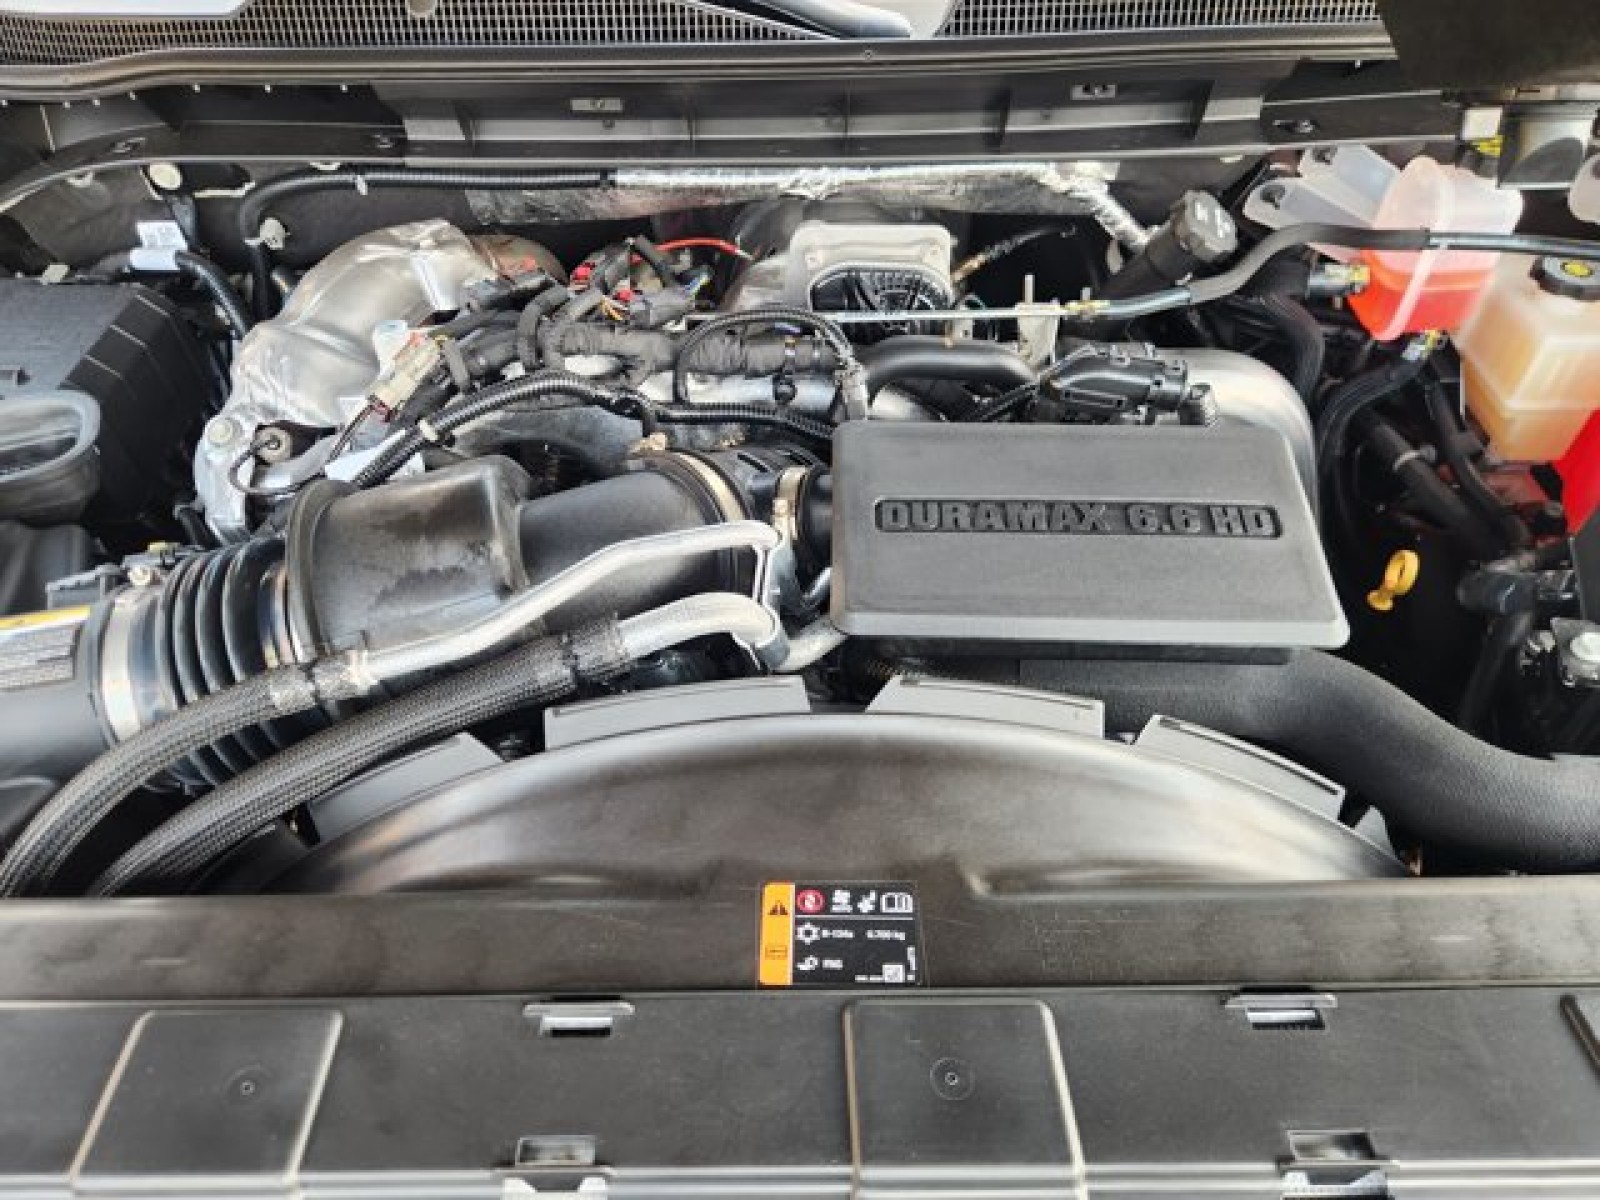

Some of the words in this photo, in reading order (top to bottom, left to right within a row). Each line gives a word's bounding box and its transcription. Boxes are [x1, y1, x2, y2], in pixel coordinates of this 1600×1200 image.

[880, 501, 1108, 533] DURAMAX
[1128, 503, 1201, 534] 6.6
[1209, 505, 1277, 537] HD
